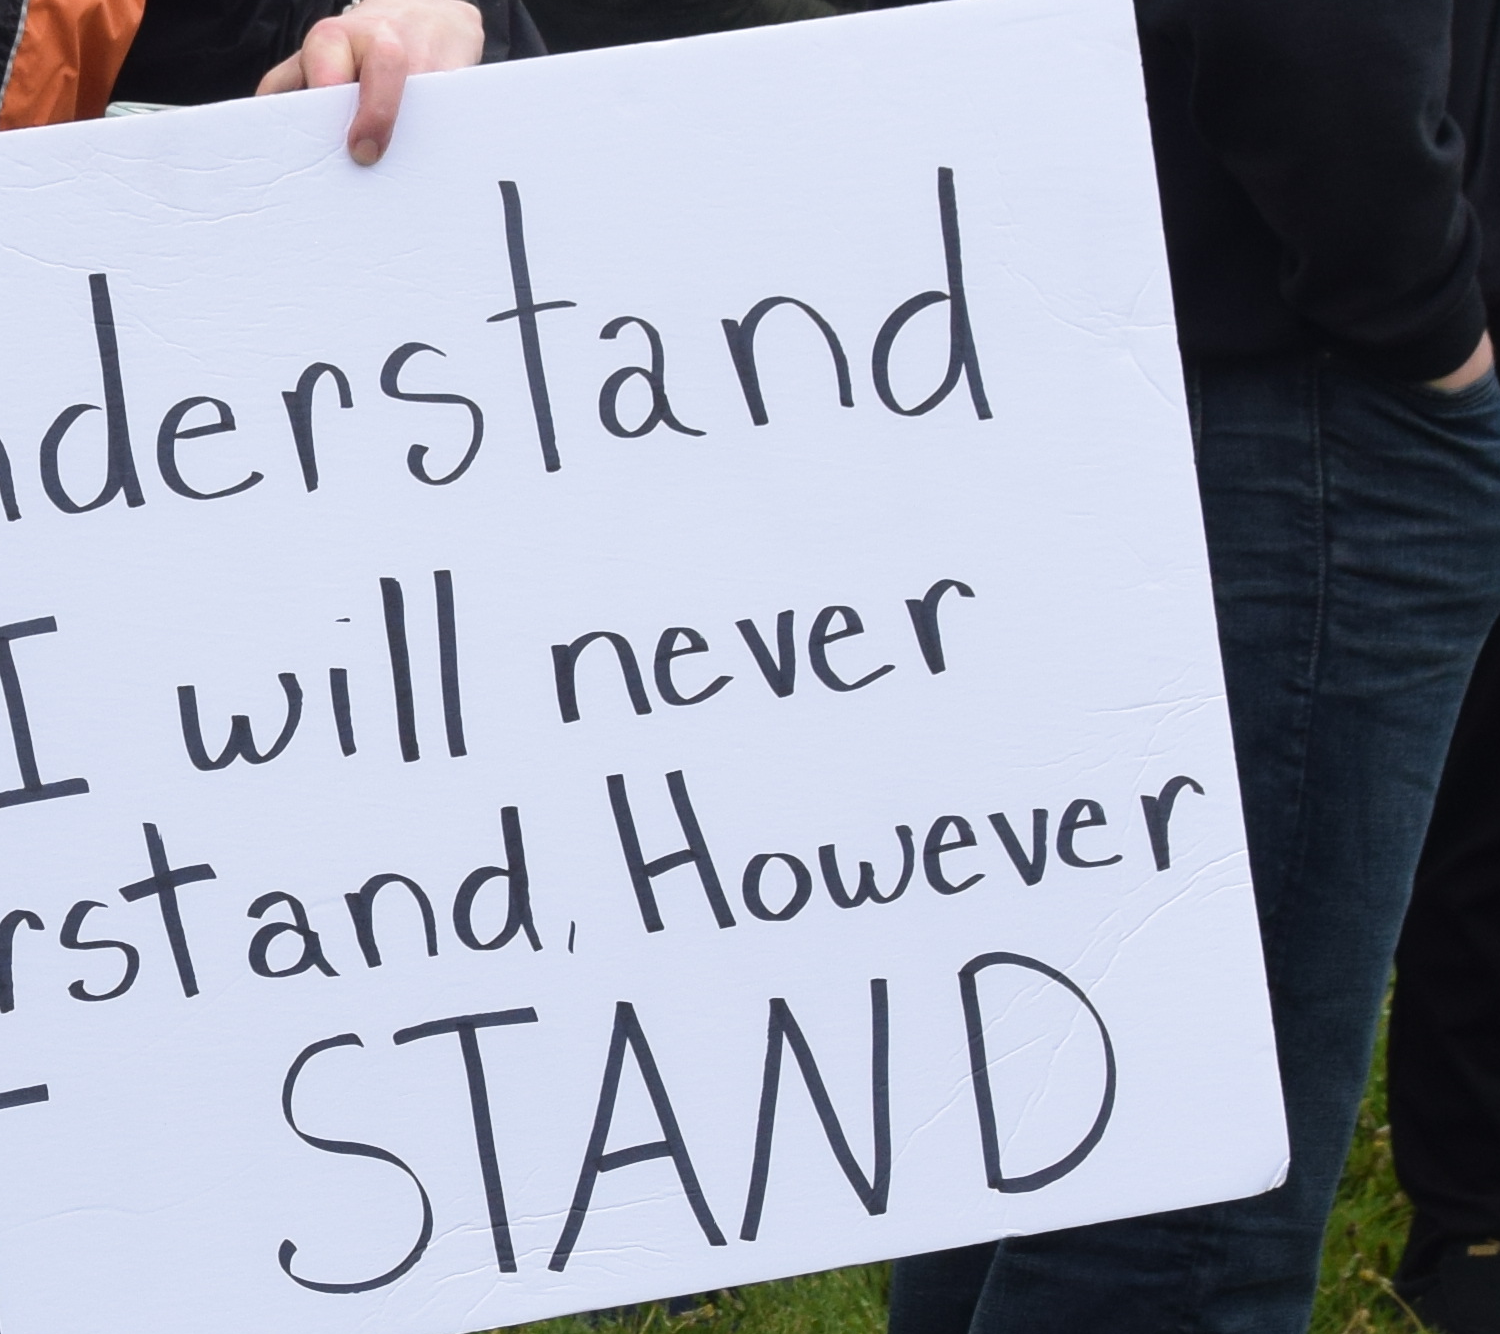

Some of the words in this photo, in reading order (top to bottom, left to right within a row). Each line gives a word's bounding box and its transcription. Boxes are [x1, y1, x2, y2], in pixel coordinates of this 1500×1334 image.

[178, 570, 467, 771] will
[552, 574, 974, 725] never
[607, 770, 1204, 933] However
[279, 952, 1116, 1294] STAND
